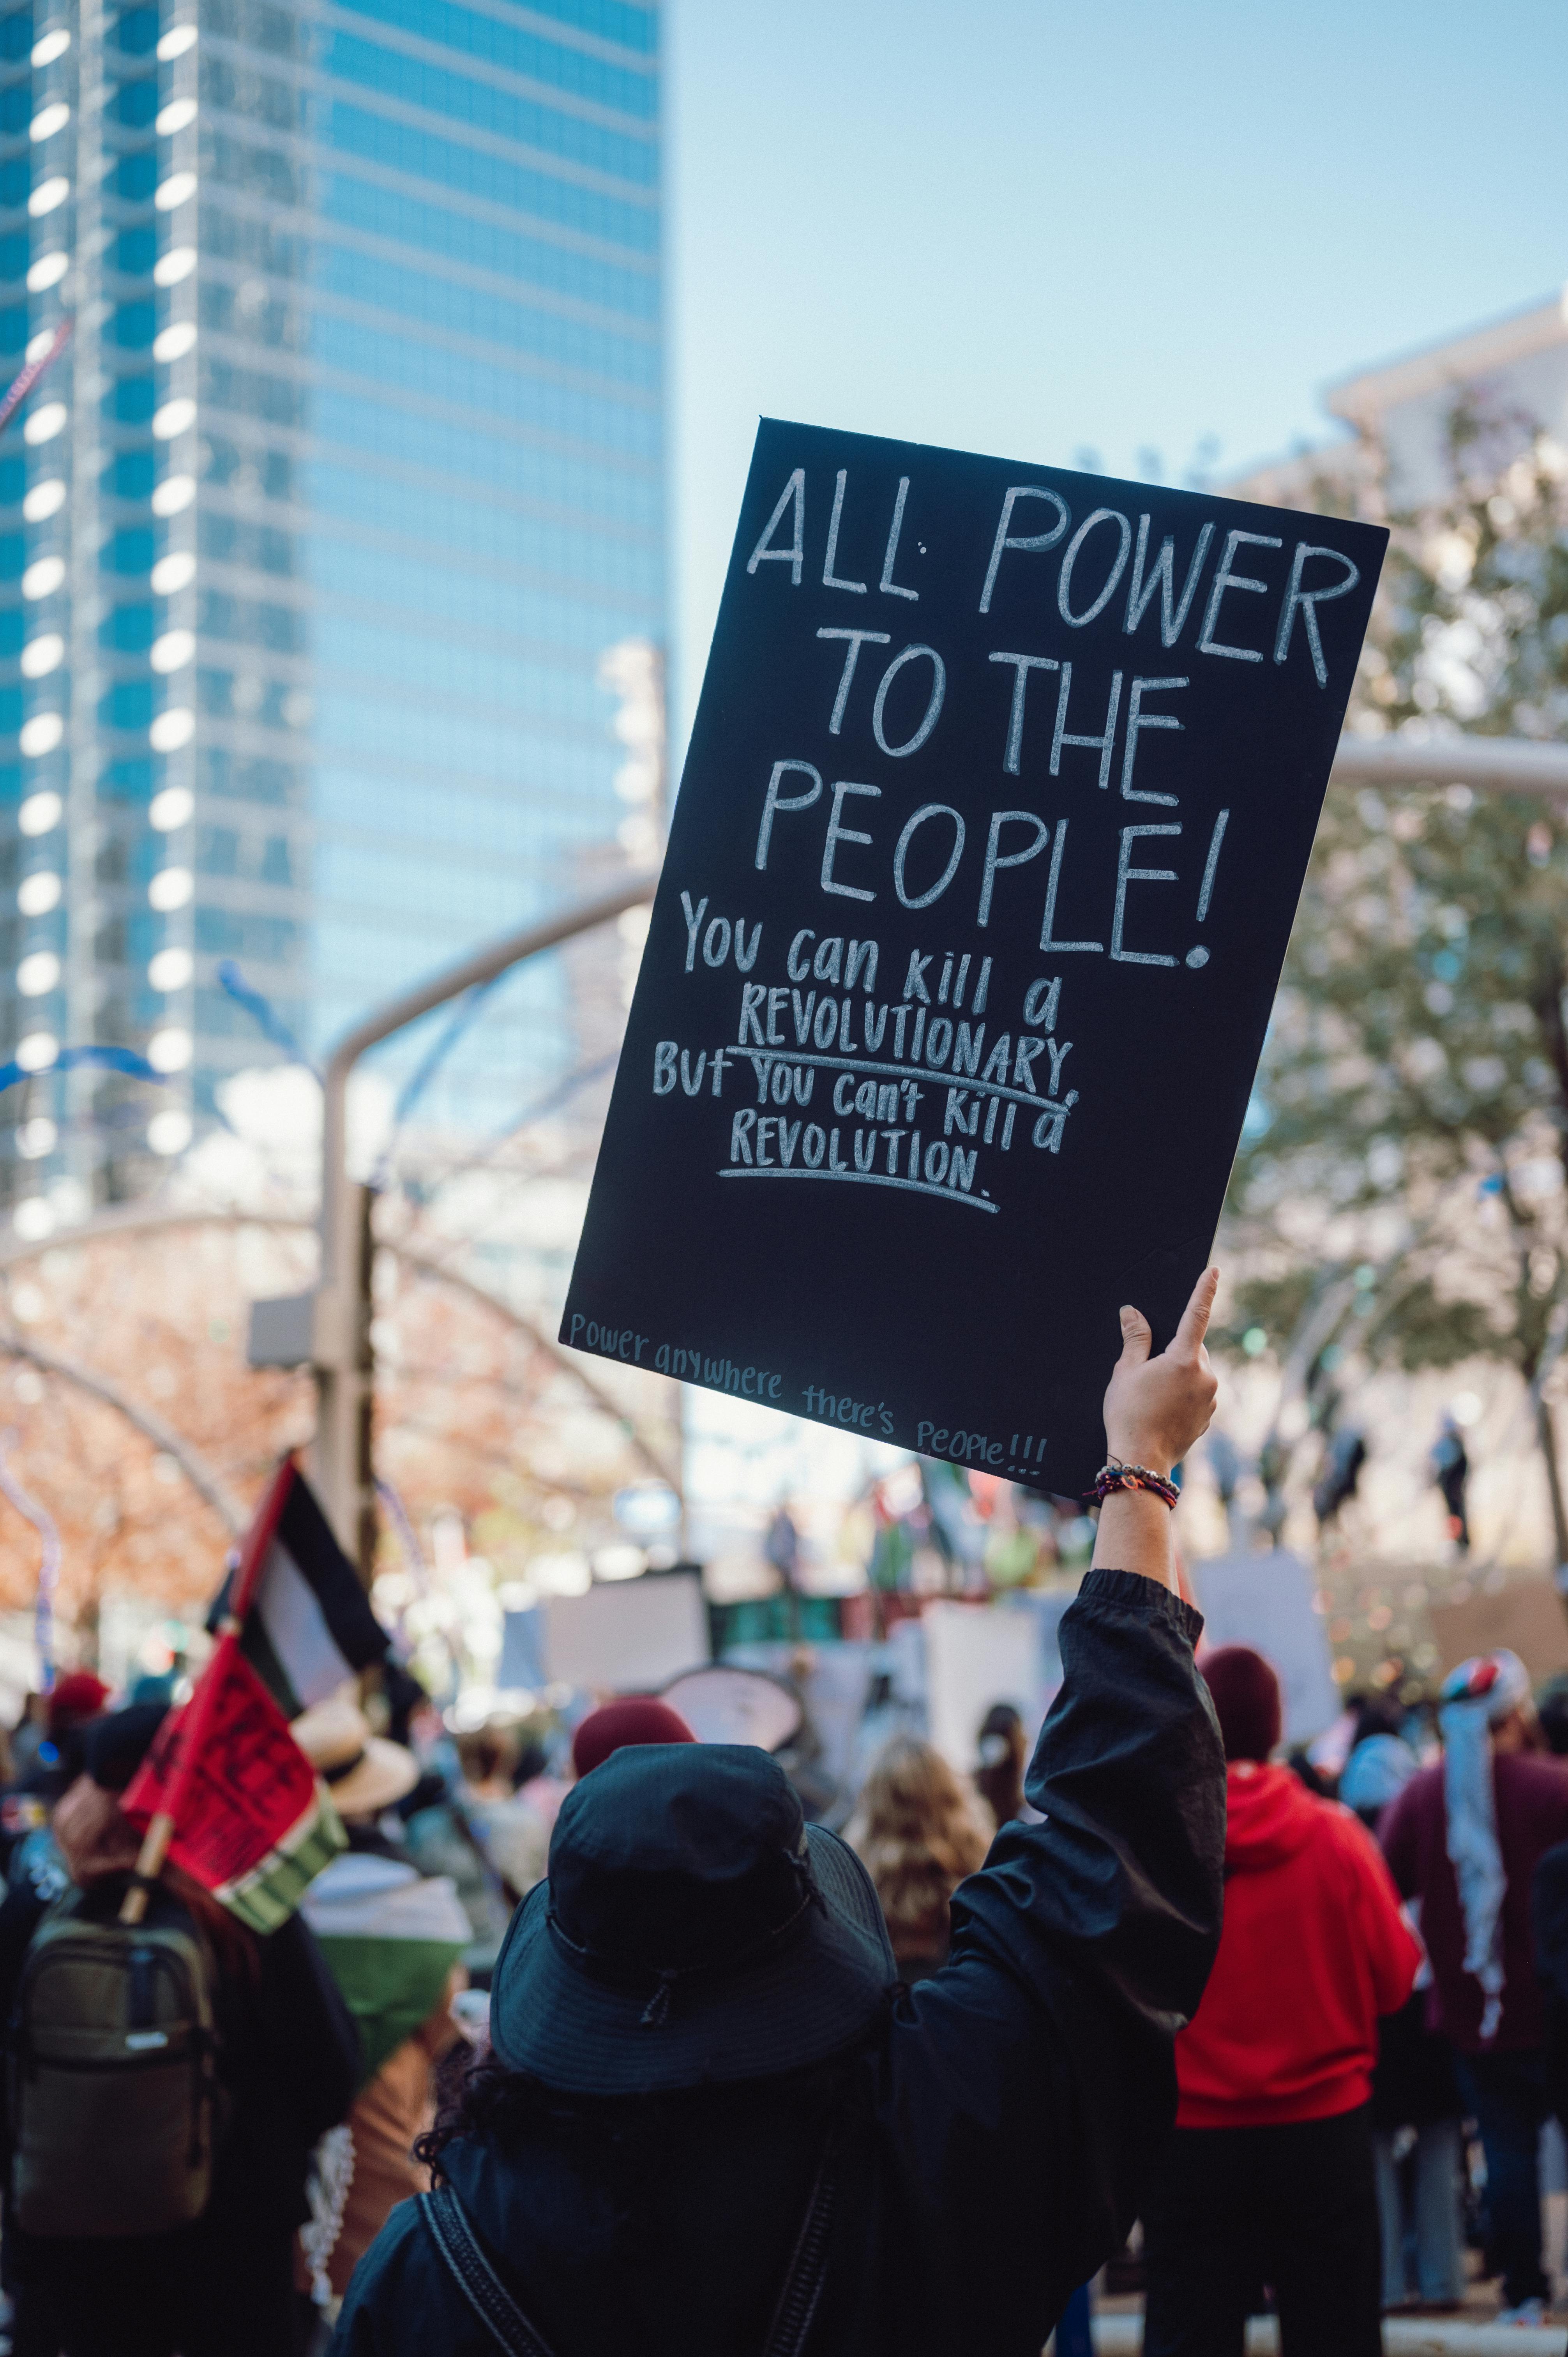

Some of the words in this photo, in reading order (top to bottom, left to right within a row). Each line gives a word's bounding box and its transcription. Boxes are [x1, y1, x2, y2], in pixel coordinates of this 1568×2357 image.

[746, 467, 919, 601] ALL
[978, 485, 1361, 689] POWER
[816, 627, 946, 758] TO
[988, 650, 1190, 806] THE
[754, 759, 1230, 968] PEOPLE!
[1023, 976, 1062, 1033] a
[730, 1108, 991, 1197] REVOLUTION.
[1031, 1110, 1068, 1154] a
[570, 1313, 649, 1361] Power
[655, 1344, 782, 1398] anywhere
[802, 1385, 894, 1434] there's
